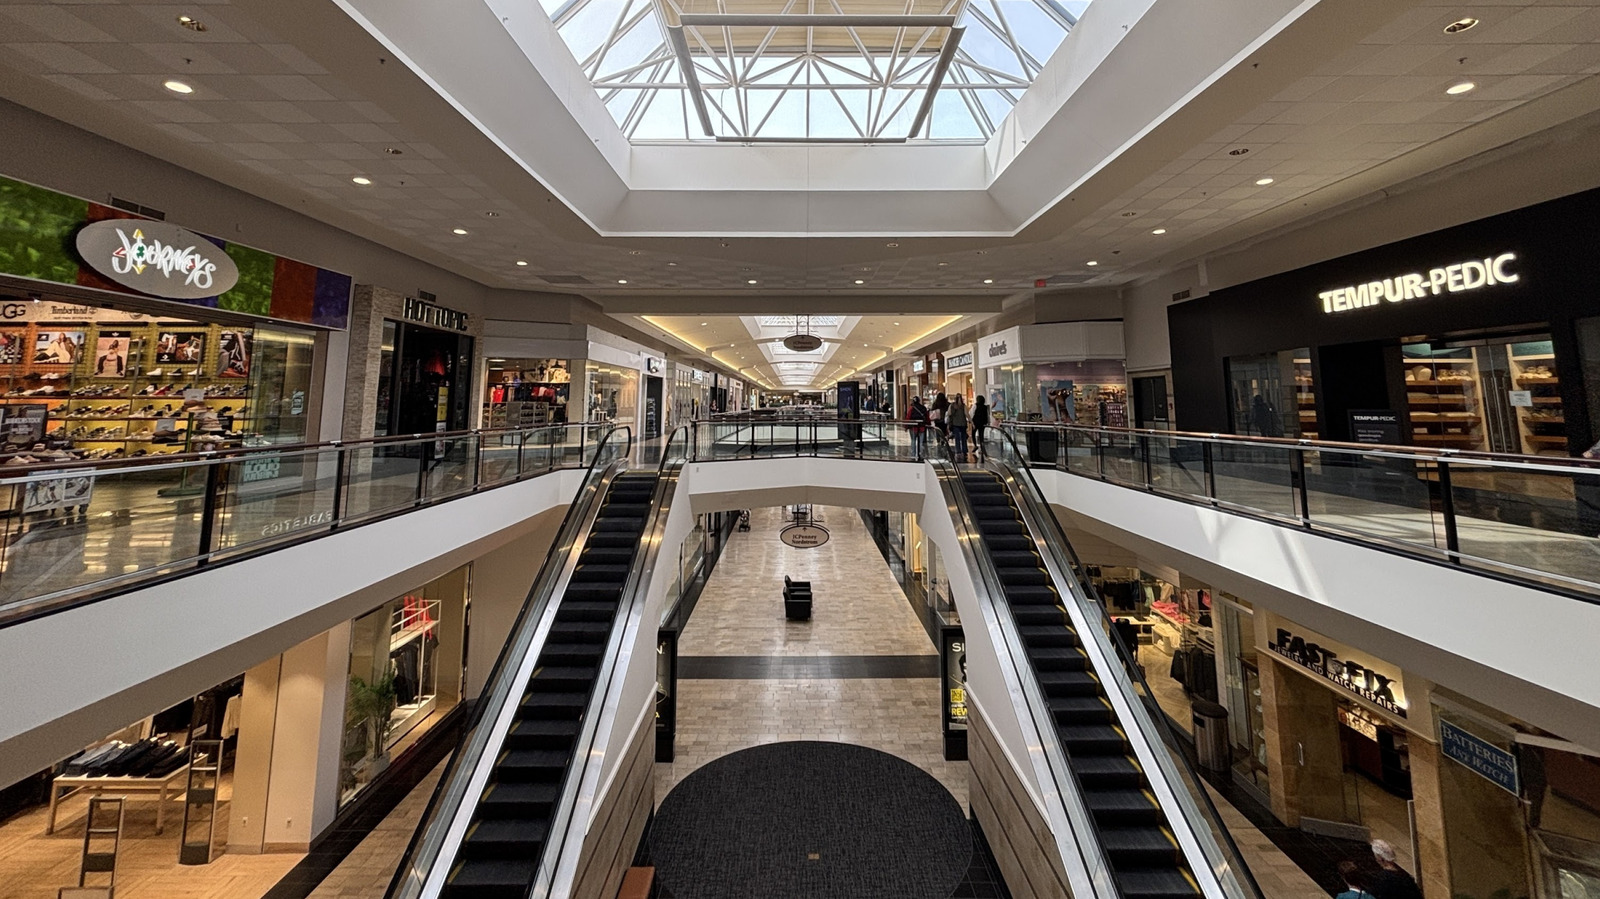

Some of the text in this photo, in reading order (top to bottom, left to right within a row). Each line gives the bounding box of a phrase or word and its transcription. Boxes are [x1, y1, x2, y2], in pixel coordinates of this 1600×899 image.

[1318, 253, 1519, 314] TEMPUR-PEDIC
[403, 297, 469, 331] HOT TOPIC
[1277, 628, 1337, 676] FAST
[1274, 645, 1399, 714] JEWELRY AND WATCH REPAIRS
[1442, 725, 1514, 773] BATTERIES
[1473, 756, 1508, 783] WATCH
